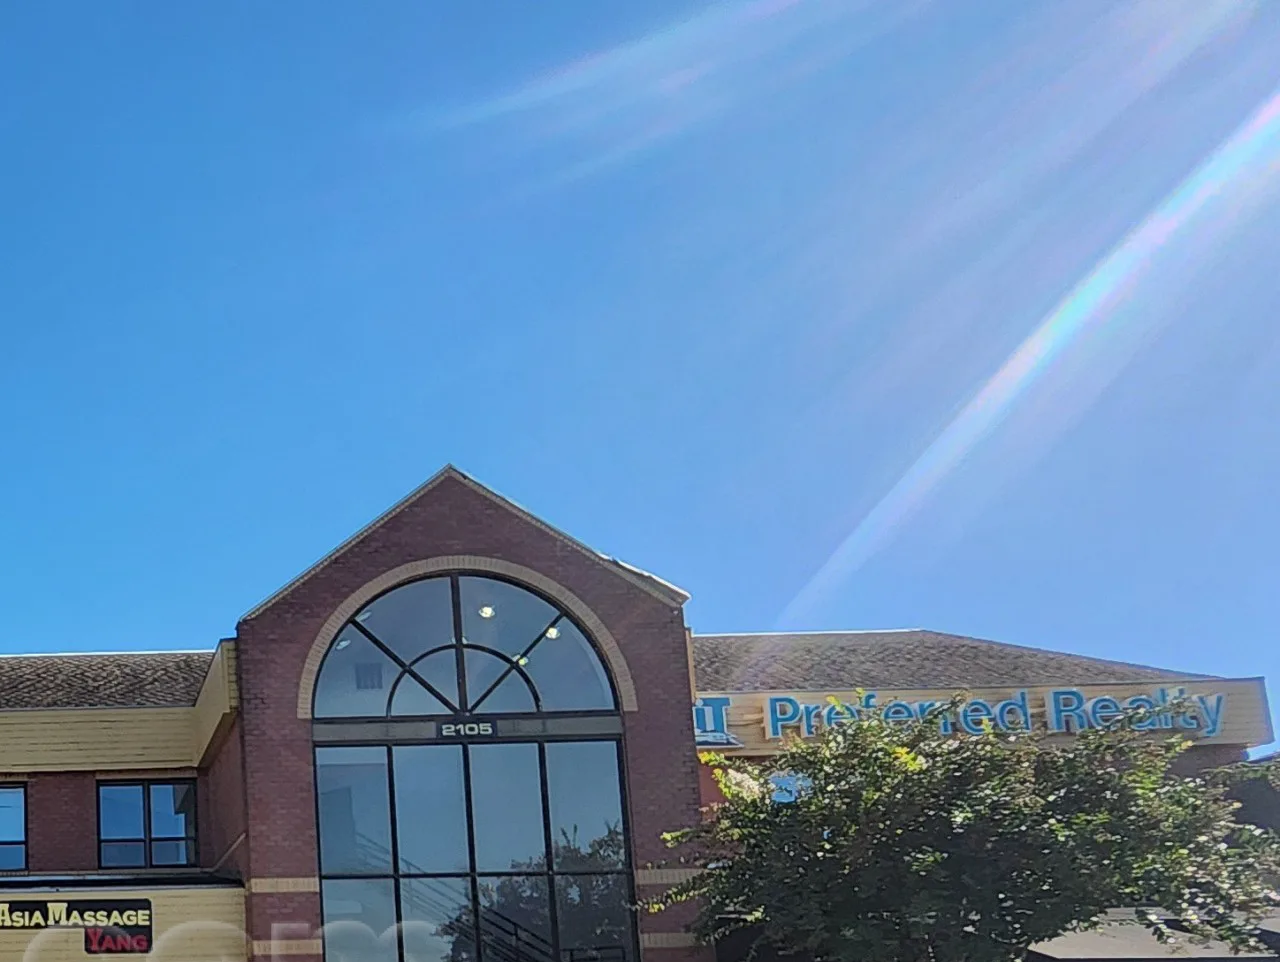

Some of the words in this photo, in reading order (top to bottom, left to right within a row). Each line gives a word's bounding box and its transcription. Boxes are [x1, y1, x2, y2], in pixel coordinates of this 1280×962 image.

[1047, 686, 1225, 737] Realty
[442, 723, 492, 736] 2105
[47, 902, 151, 926] MASSAGE
[86, 928, 149, 951] YANG
